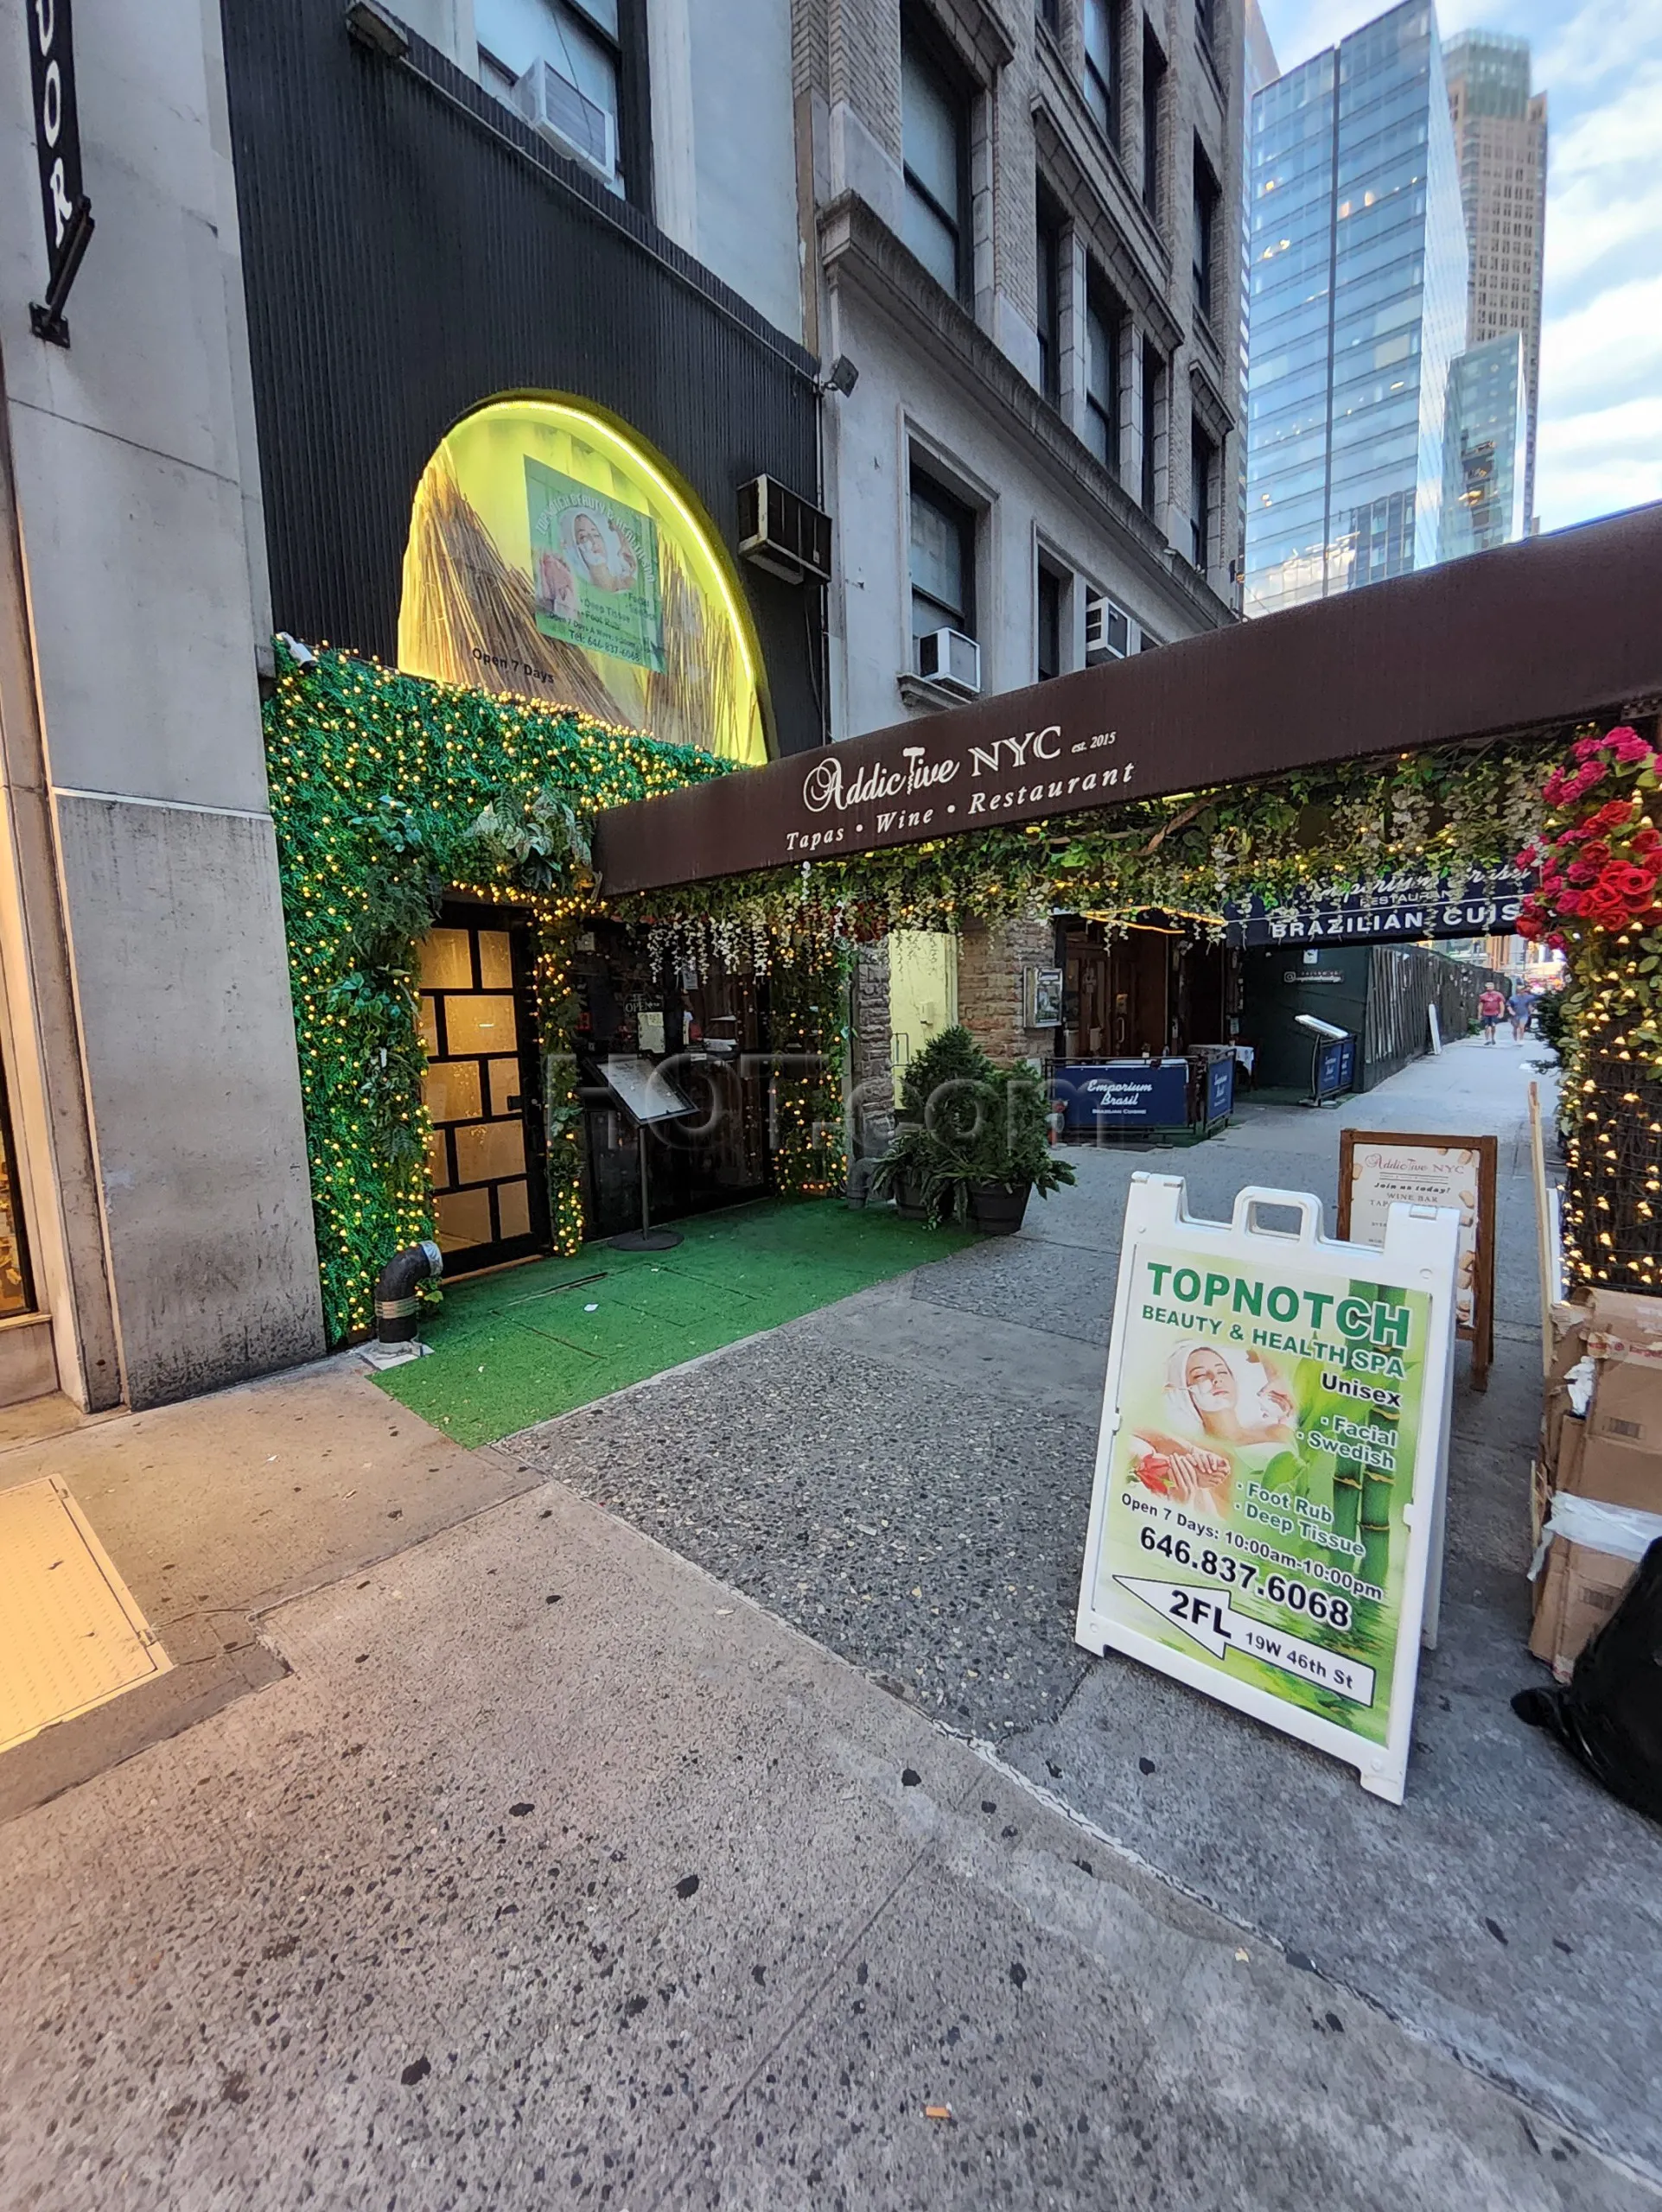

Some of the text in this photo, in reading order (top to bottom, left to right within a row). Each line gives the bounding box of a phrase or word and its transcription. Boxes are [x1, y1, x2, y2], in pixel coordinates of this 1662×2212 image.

[472, 647, 555, 683] Open 7 Days
[967, 725, 1062, 777] NYC
[1089, 731, 1118, 750] 2015
[786, 761, 1135, 851] Tapas Wine Restaurant
[1271, 902, 1521, 939] BRAZILIAN CUIS
[1086, 1079, 1153, 1095] Emporium
[1100, 1092, 1139, 1106] Brasil
[1432, 1164, 1465, 1174] NYC
[1386, 1192, 1415, 1201] WINE
[1147, 1262, 1410, 1348] TOPNOTCH
[1141, 1305, 1405, 1379] BEAUTY & HEALTH SPA
[1321, 1373, 1402, 1408] Unisex
[1309, 1432, 1395, 1469] Swedish
[1334, 1416, 1397, 1448] Facial
[1248, 1482, 1334, 1524] Foot Rub
[1121, 1492, 1383, 1600] Open 7 Days: 10:00am-10:00pm
[1245, 1503, 1367, 1558] Deep Tissue
[1139, 1526, 1351, 1629] 646.837.6068
[1168, 1589, 1232, 1640] 2FL
[1245, 1632, 1354, 1690] 19W 46th St
